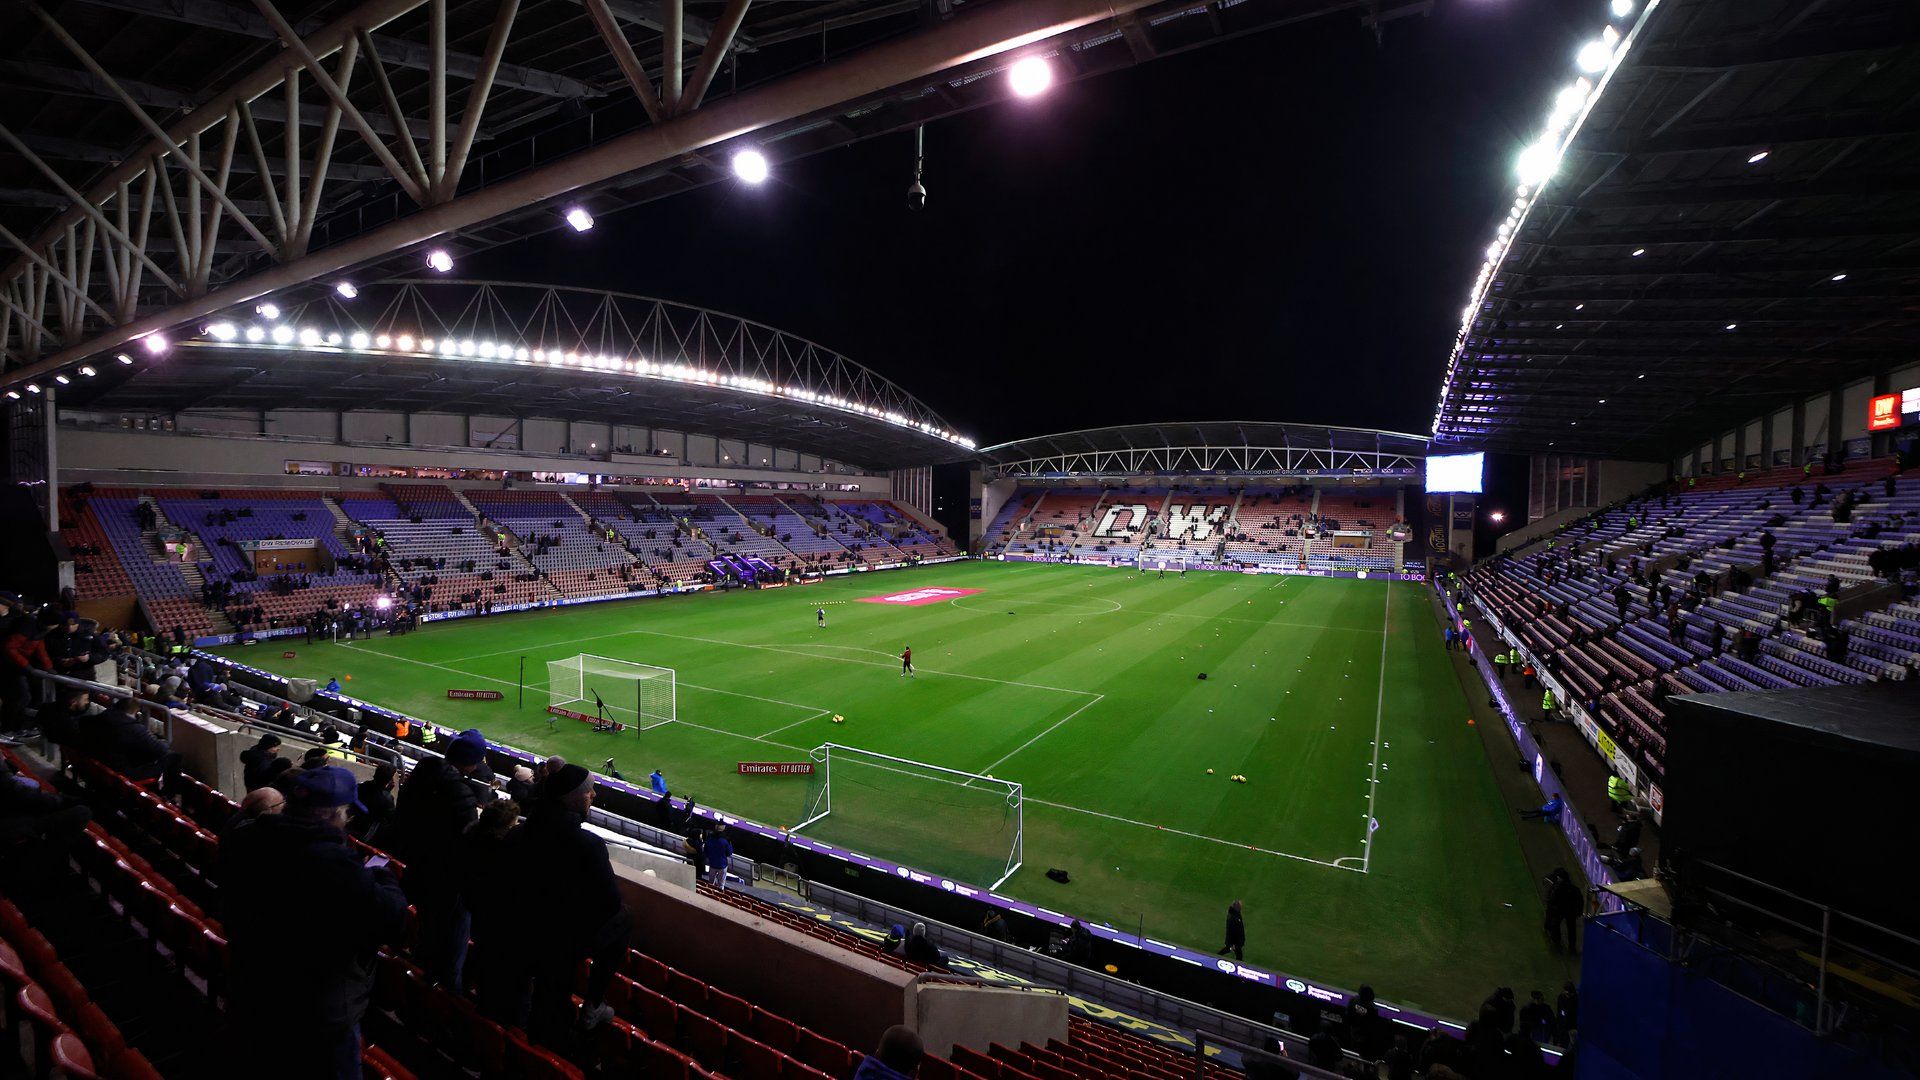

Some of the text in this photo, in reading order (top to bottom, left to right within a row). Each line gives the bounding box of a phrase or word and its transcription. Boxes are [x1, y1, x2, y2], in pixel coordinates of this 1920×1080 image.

[741, 764, 811, 773] Emirates FLY BETTER
